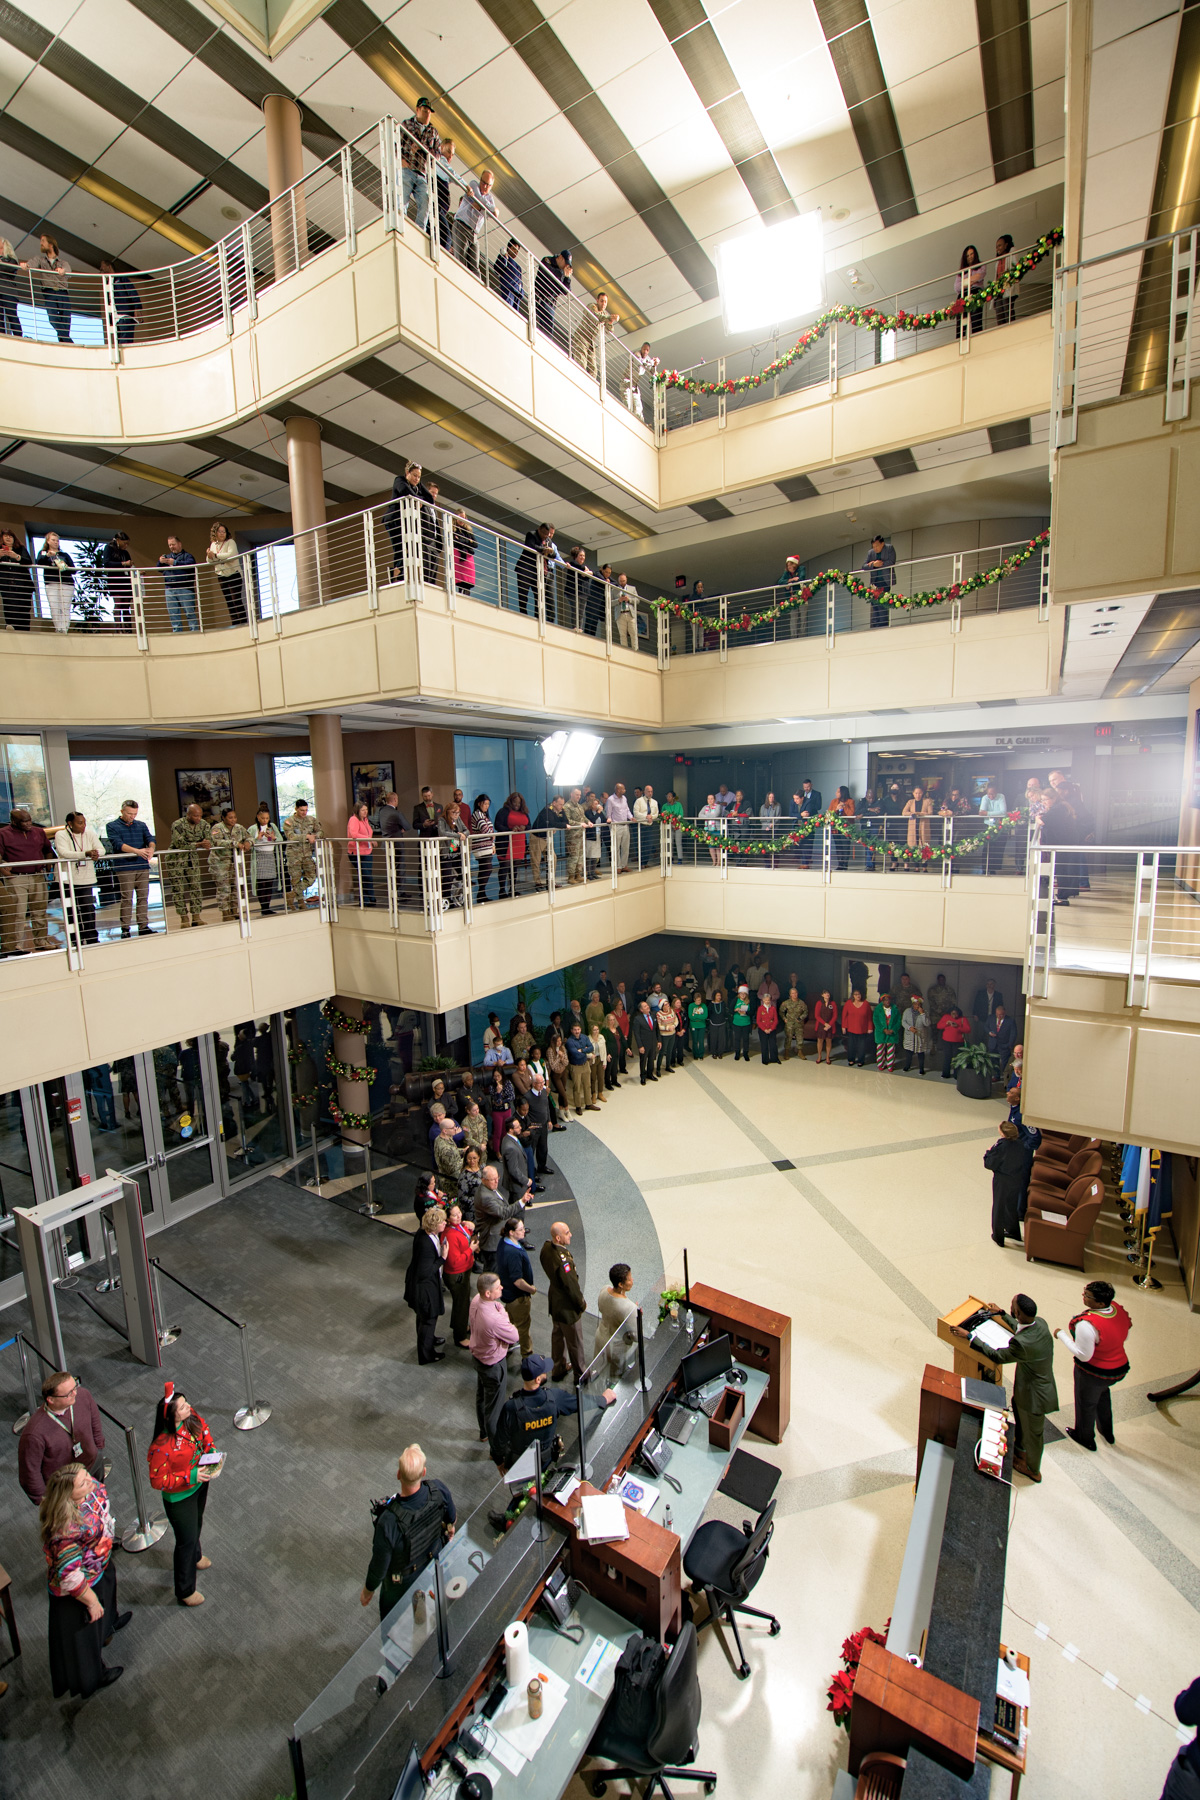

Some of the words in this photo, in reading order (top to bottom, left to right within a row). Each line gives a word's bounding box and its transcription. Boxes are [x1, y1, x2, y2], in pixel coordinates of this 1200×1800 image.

[1096, 727, 1111, 736] EXIT
[525, 1416, 553, 1431] POLICE
[622, 1482, 633, 1497] POLICE
